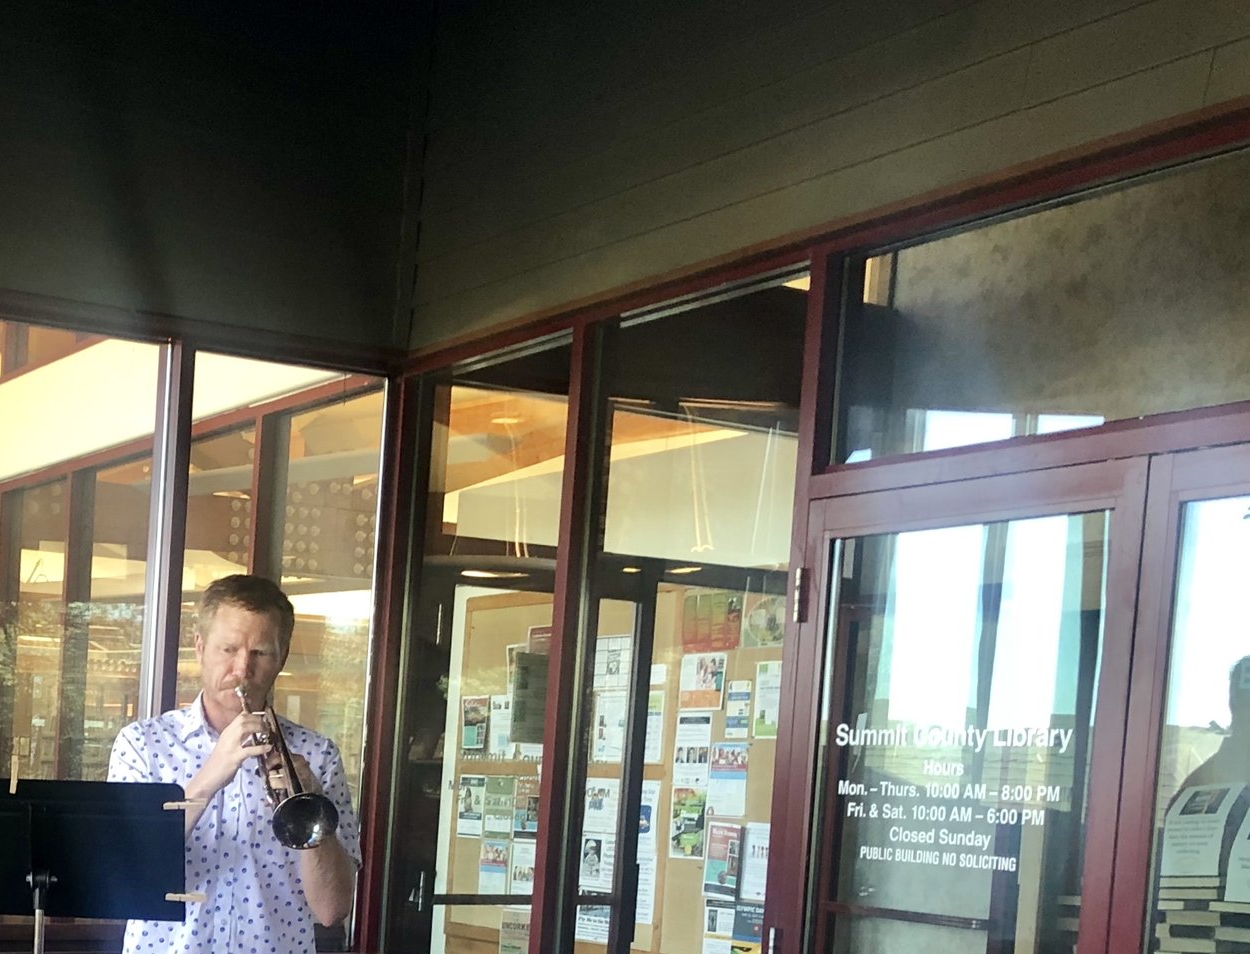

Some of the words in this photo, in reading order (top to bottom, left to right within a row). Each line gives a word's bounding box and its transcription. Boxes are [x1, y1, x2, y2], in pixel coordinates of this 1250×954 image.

[835, 723, 907, 747] Summit
[913, 725, 987, 752] County
[993, 726, 1073, 753] Library
[923, 759, 964, 777] Hours
[838, 780, 868, 796] Mon.
[880, 781, 920, 798] Thurs.
[925, 783, 960, 799] 10:00
[963, 783, 986, 800] AM
[1001, 785, 1031, 801] 8:00
[1036, 785, 1061, 802] PM
[847, 803, 866, 818] Fri.
[869, 804, 879, 818] &
[912, 805, 946, 822] 10:00
[949, 807, 973, 823] AM
[986, 808, 1018, 825] 6:00
[1021, 809, 1045, 826] PM
[889, 826, 935, 844] Closed
[939, 829, 991, 851] Sunday
[860, 846, 893, 862] PUBLIC
[895, 848, 940, 866] BUILDING
[942, 851, 957, 867] NO
[959, 853, 1017, 872] SOLICITING
